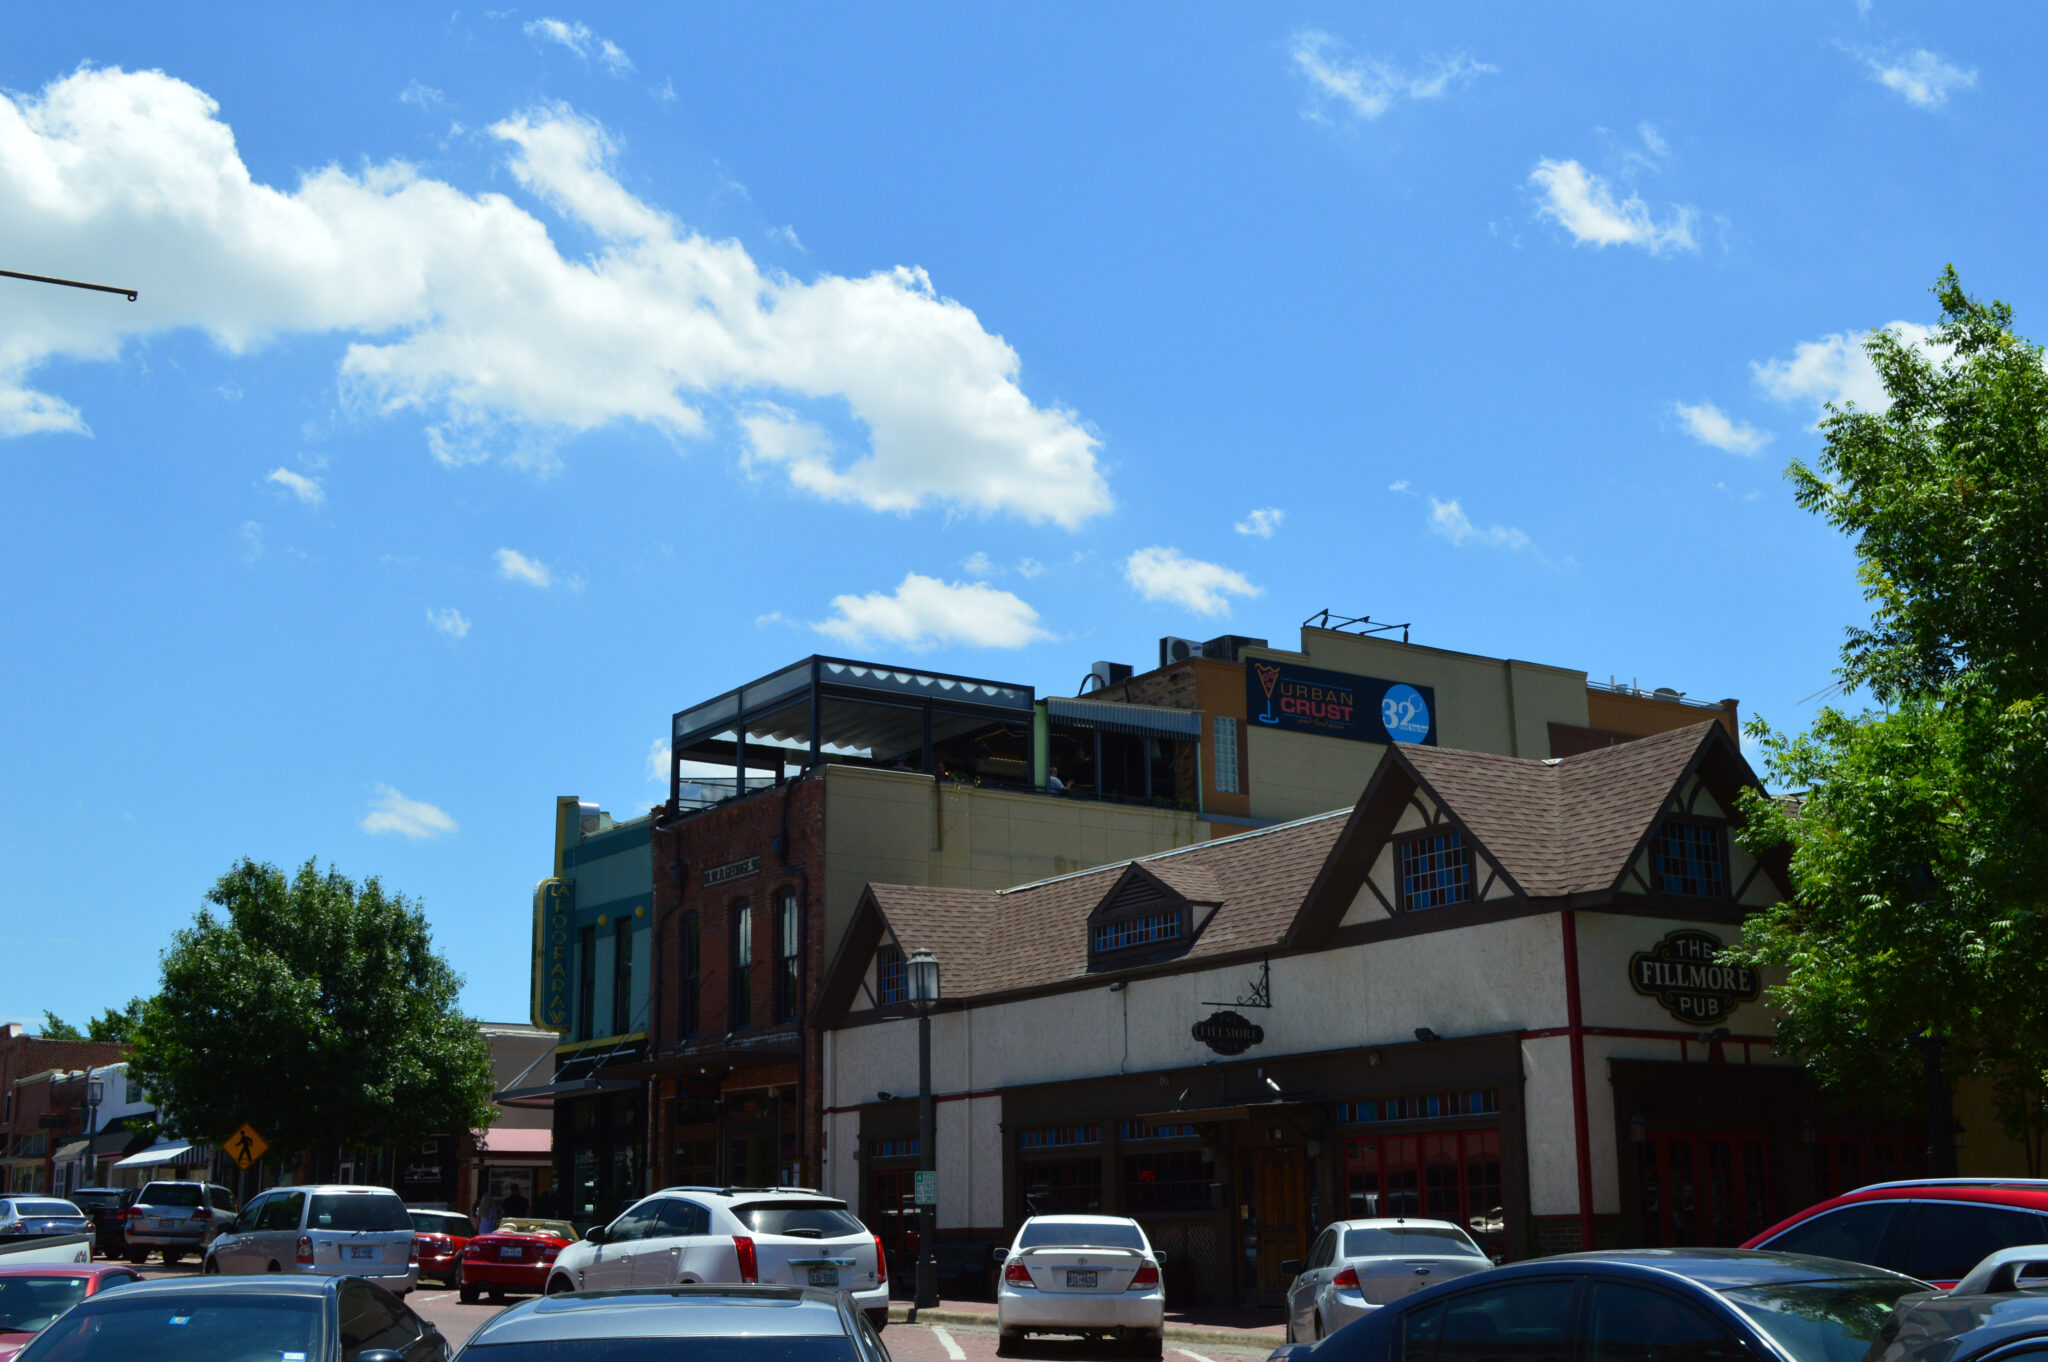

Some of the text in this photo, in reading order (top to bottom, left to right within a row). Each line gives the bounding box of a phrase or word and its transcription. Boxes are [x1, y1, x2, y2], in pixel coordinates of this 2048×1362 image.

[1281, 682, 1353, 706] URBAN
[1281, 697, 1354, 722] CRUST
[551, 884, 570, 897] LA
[1676, 939, 1713, 959] THE
[1641, 961, 1751, 992] FILLMORE
[1679, 997, 1720, 1017] PUB
